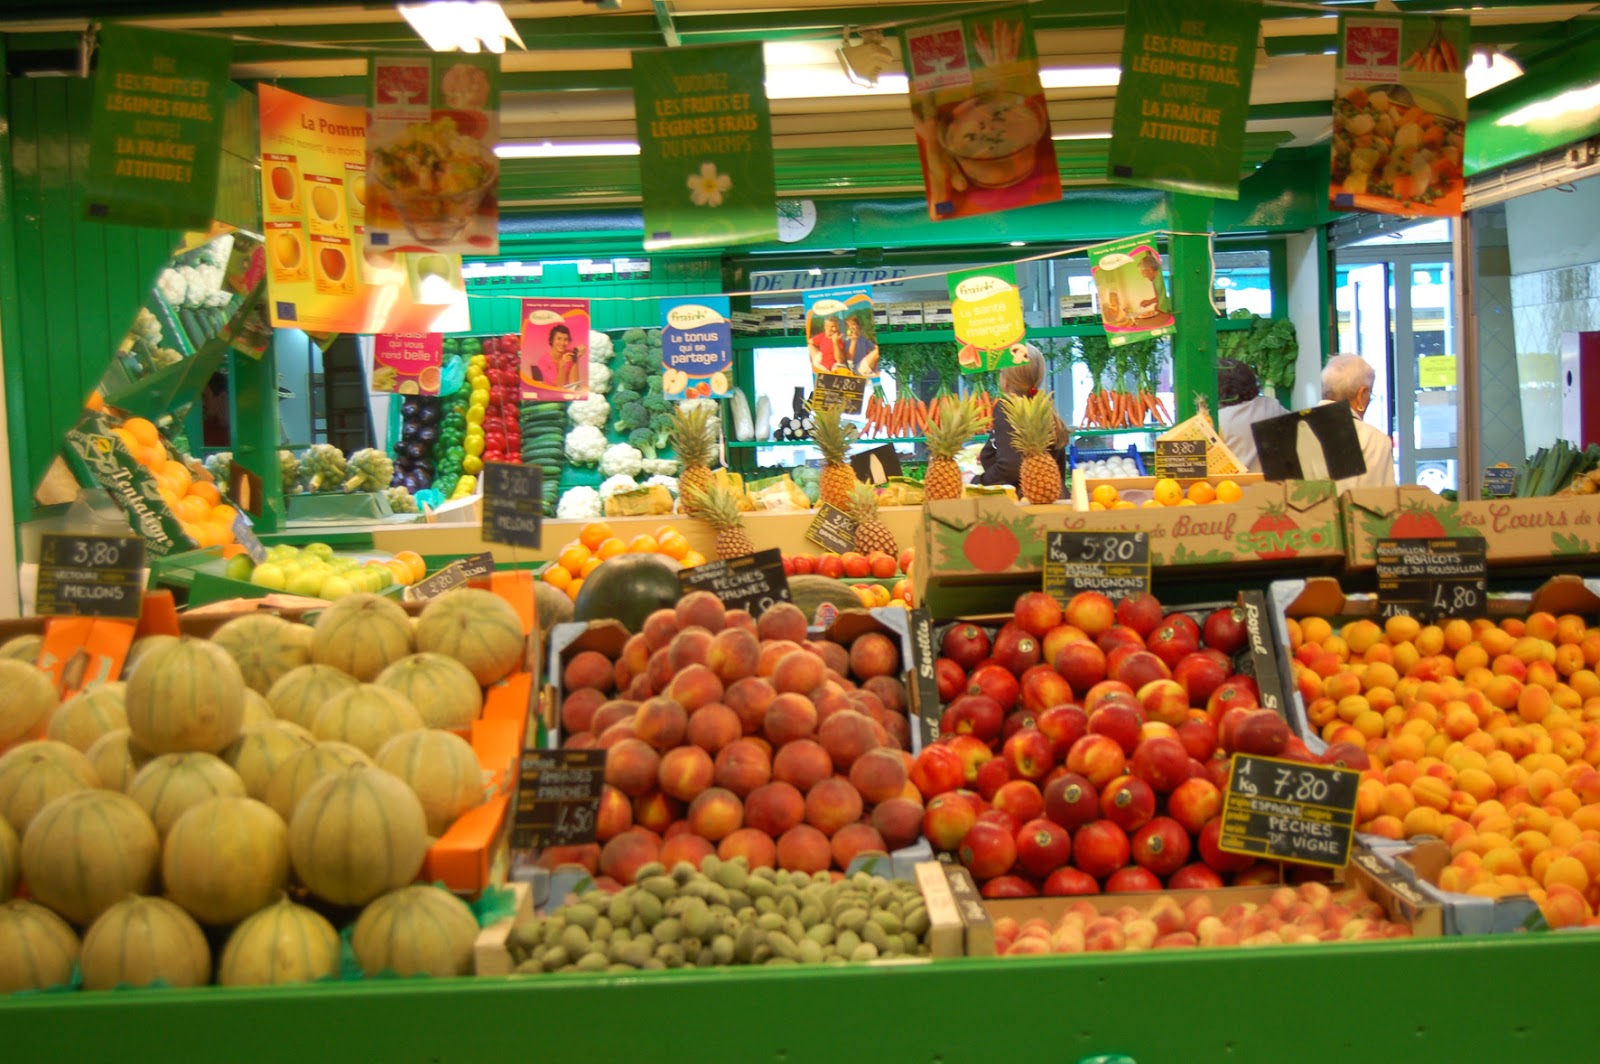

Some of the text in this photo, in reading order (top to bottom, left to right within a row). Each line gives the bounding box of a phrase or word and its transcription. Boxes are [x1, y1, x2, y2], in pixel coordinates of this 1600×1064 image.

[1143, 34, 1238, 62] LES FRUITS ET
[1133, 53, 1196, 79] LÉGUMES
[655, 93, 750, 116] LES FRUITS ET
[1142, 99, 1160, 116] LA
[301, 113, 315, 131] La
[651, 113, 757, 138] LÉGUMES FRAIS
[753, 275, 783, 292] DE
[388, 341, 425, 349] qui vous
[671, 332, 719, 343] Le tonus
[381, 351, 402, 359] rend
[404, 349, 431, 361] belle
[679, 343, 693, 353] qui
[671, 352, 718, 366] partage
[112, 466, 168, 543] Tentation
[1460, 511, 1485, 526] Les
[1574, 509, 1592, 525] de
[1151, 524, 1166, 538] de
[1403, 554, 1461, 565] ABRICOTS
[1376, 565, 1410, 575] ROUGE
[1427, 563, 1484, 575] ROUSSILLON
[1073, 577, 1144, 588] BRUGNONS
[63, 584, 125, 600] MELONS
[1245, 602, 1268, 655] Royal
[917, 619, 934, 680] Sevilla
[1250, 800, 1301, 816] ESPAGNE
[1269, 815, 1333, 837] PÊCHES
